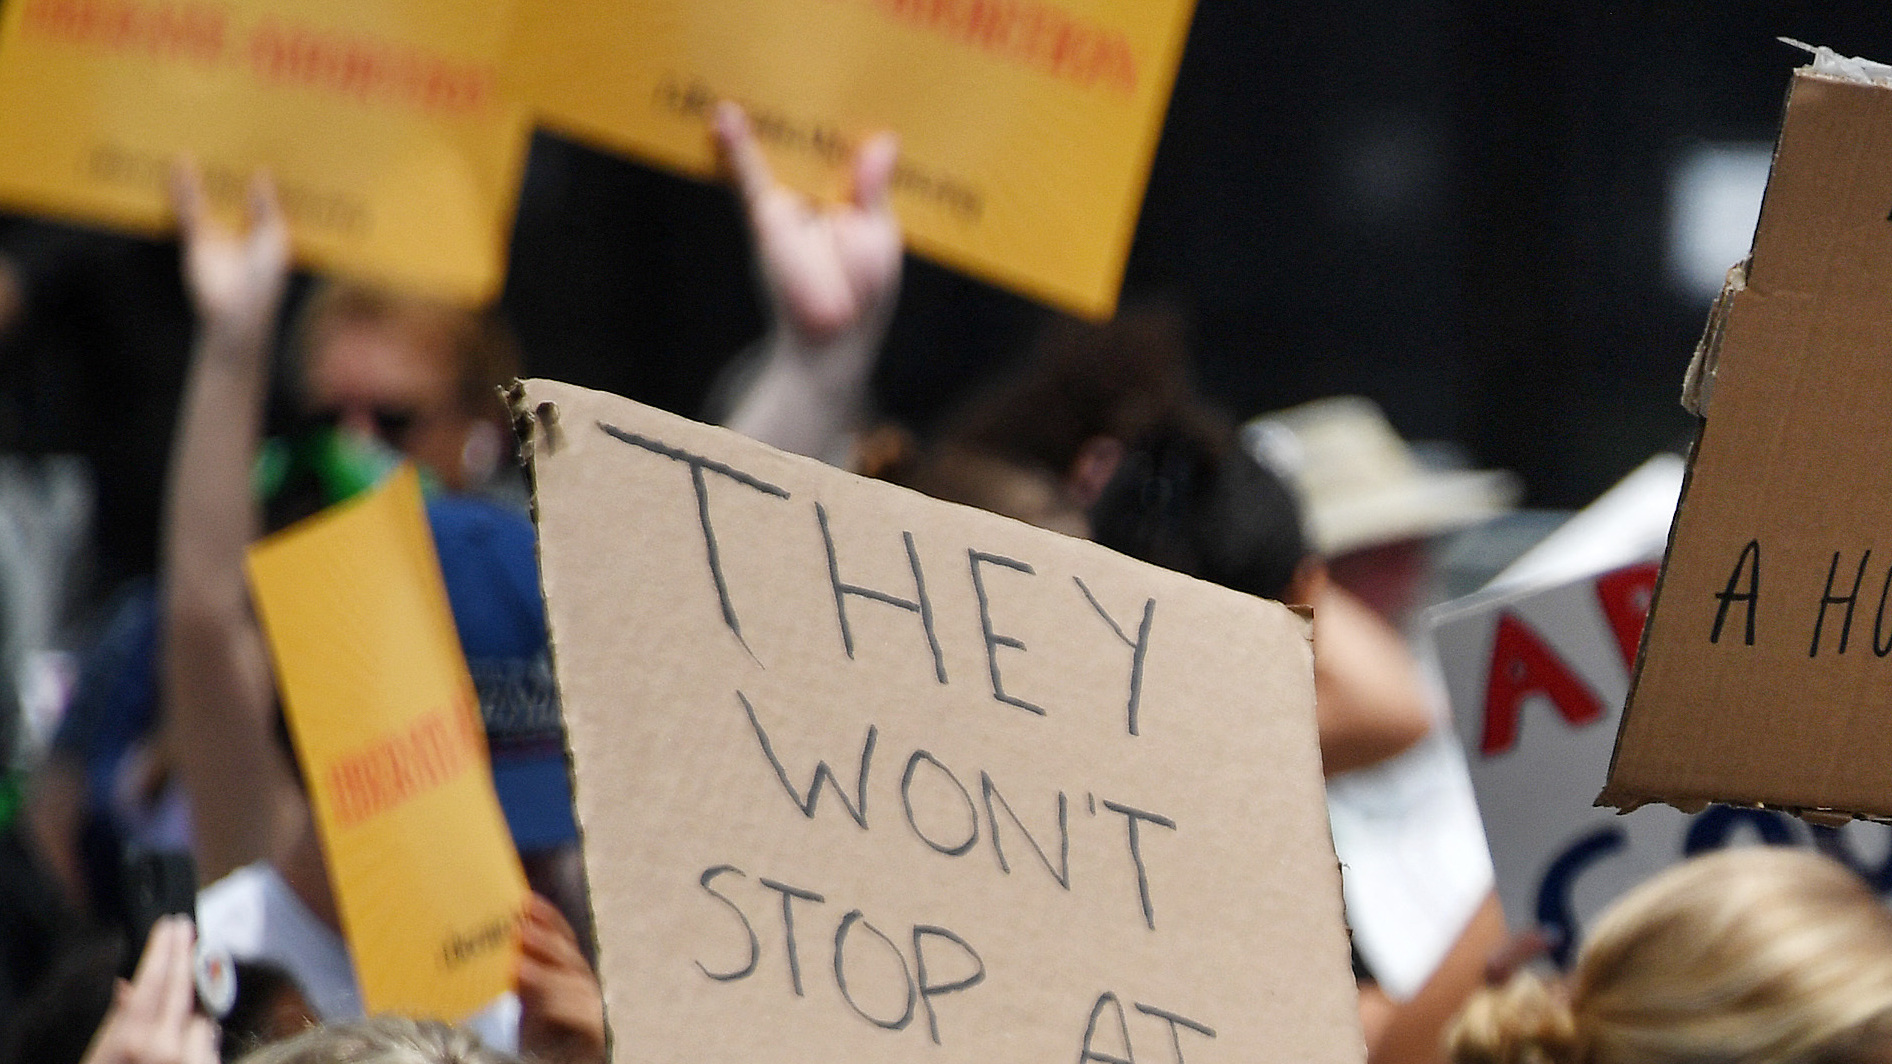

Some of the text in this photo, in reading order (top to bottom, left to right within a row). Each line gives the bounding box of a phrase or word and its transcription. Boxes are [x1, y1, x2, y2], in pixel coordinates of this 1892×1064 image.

[597, 421, 1156, 736] THEY
[1710, 538, 1762, 646] A
[736, 689, 1177, 931] WON'T
[694, 864, 986, 1046] STOP
